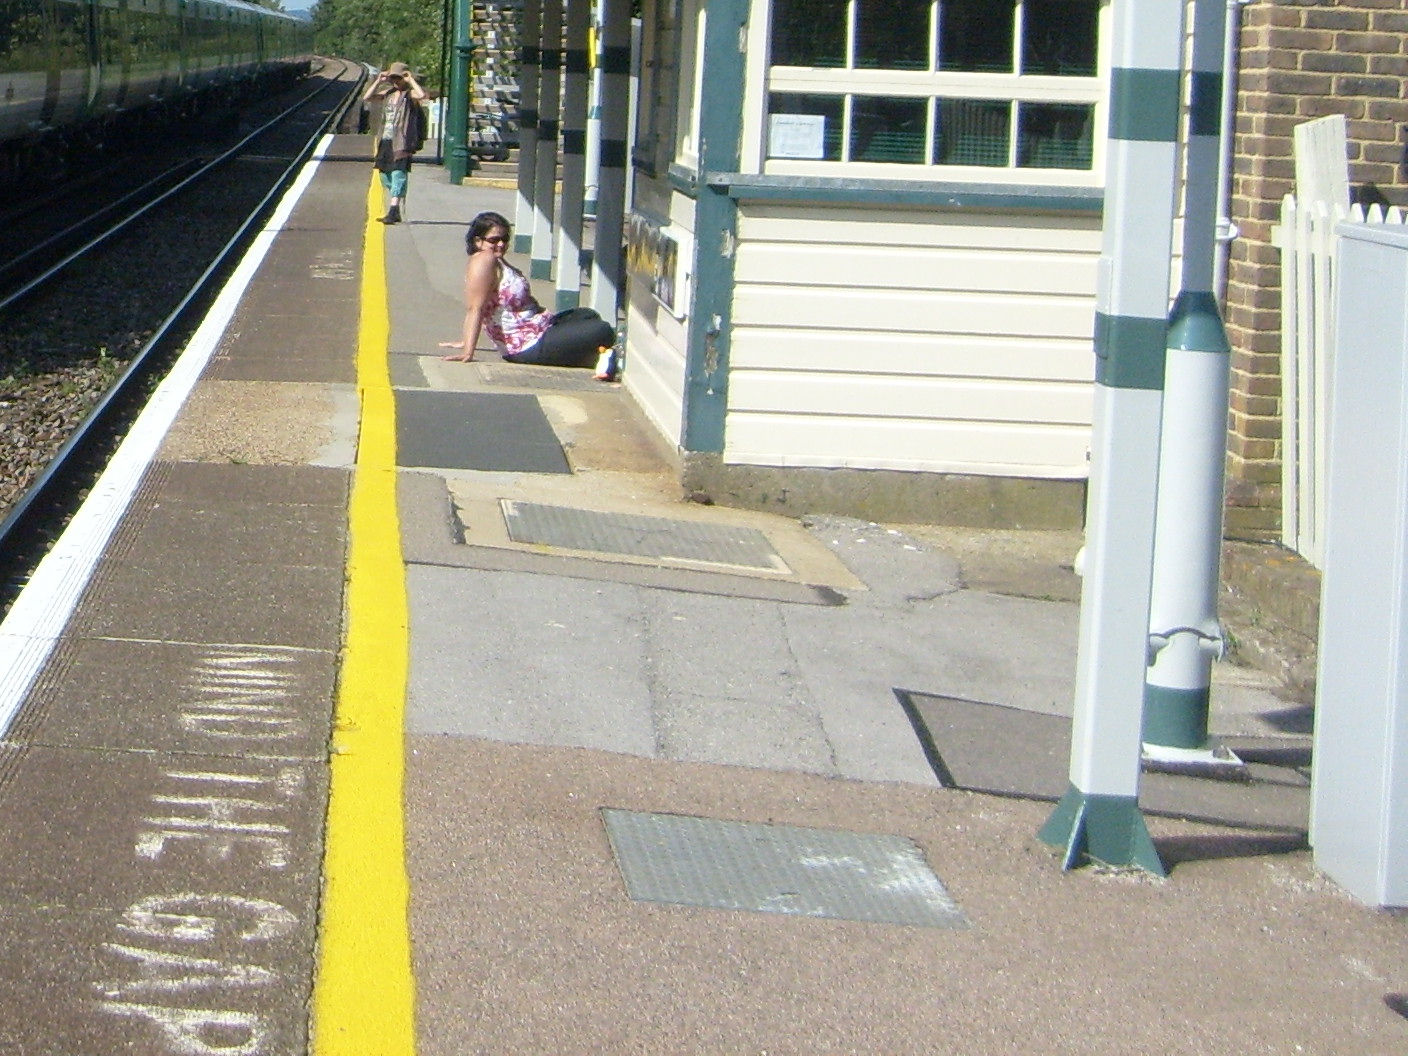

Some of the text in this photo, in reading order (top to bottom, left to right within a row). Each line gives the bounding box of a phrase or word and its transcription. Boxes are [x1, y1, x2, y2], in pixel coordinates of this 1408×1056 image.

[91, 650, 306, 1056] MIND THE GAP
